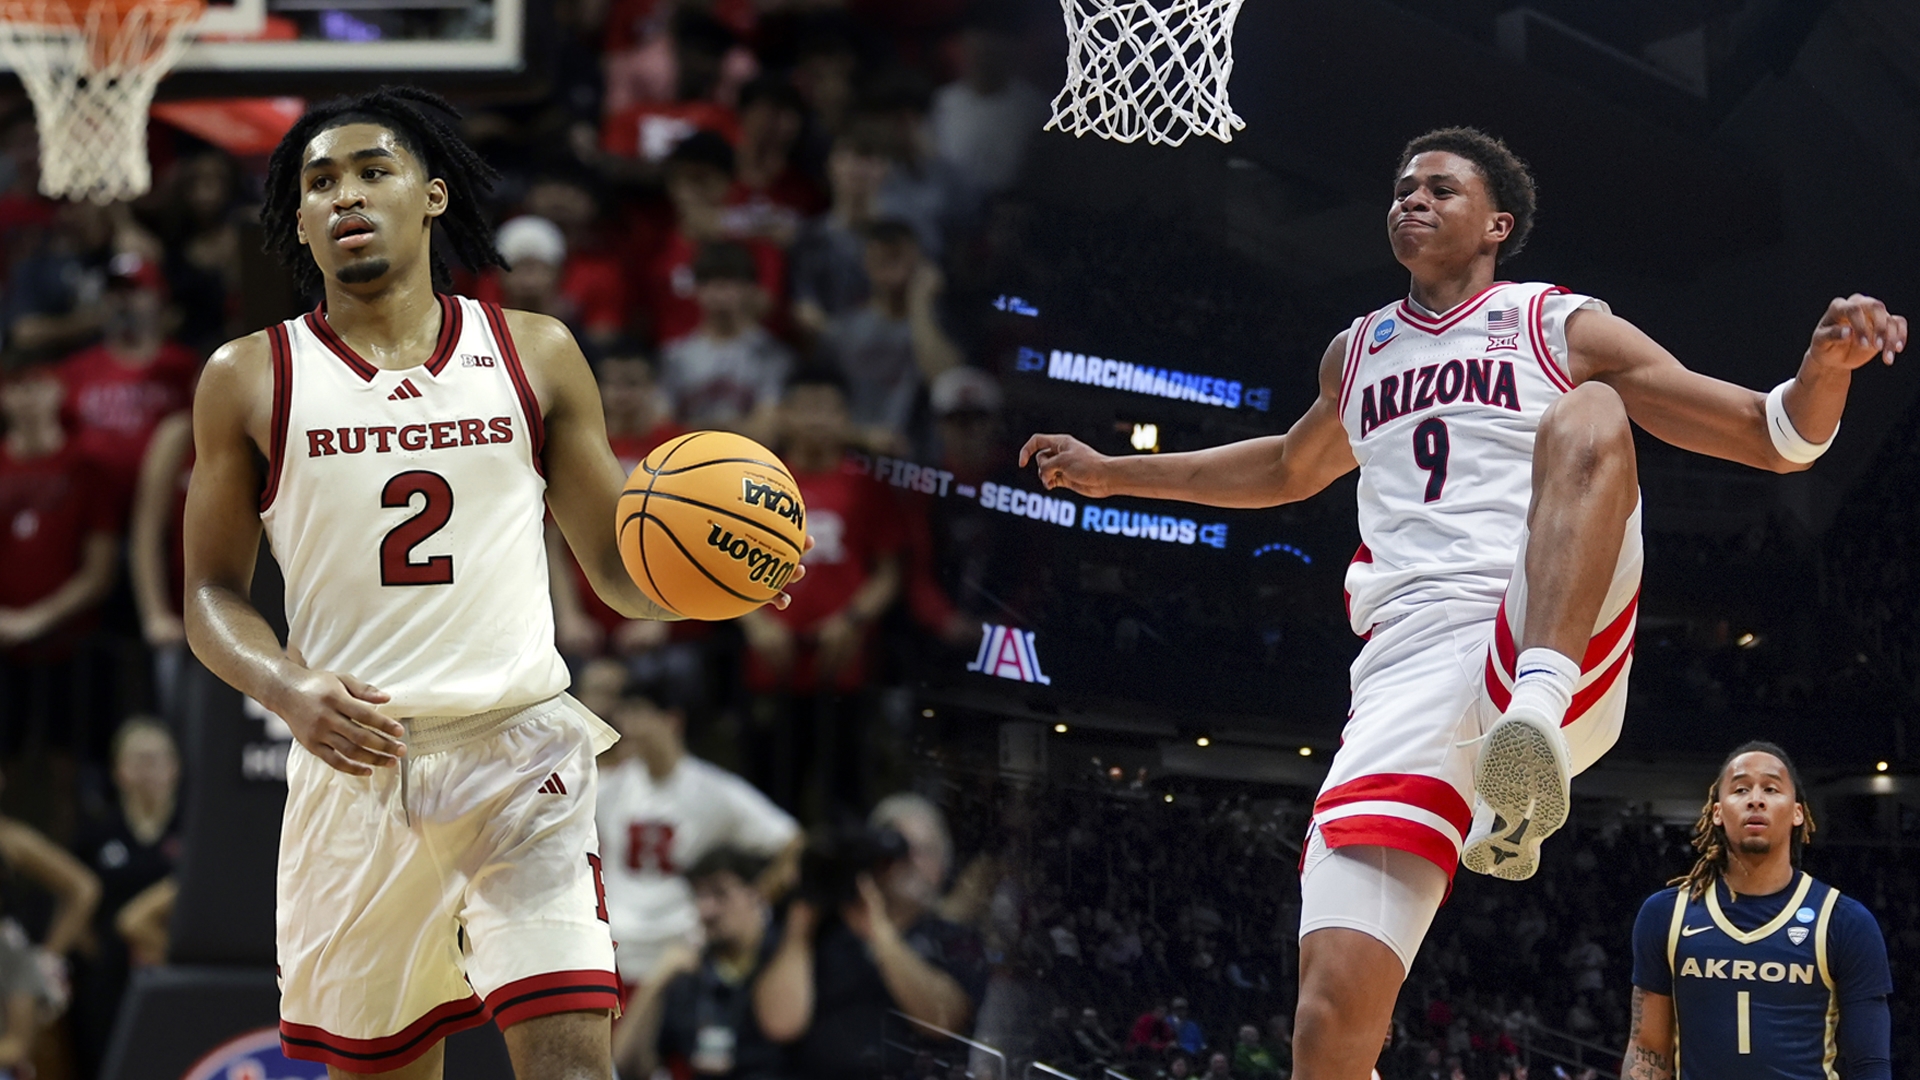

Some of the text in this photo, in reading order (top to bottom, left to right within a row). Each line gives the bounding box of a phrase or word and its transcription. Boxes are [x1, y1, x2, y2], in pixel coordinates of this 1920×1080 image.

[1361, 359, 1521, 440] ARIZONA
[306, 417, 513, 457] RUTGERS
[1413, 418, 1450, 503] 9
[380, 470, 454, 586] 2
[742, 478, 804, 531] NCAA
[874, 456, 1198, 545] FIRST SECOND ROUNDS
[707, 523, 795, 590] Wilson
[1680, 957, 1815, 985] AKRON
[1737, 991, 1751, 1054] 1
